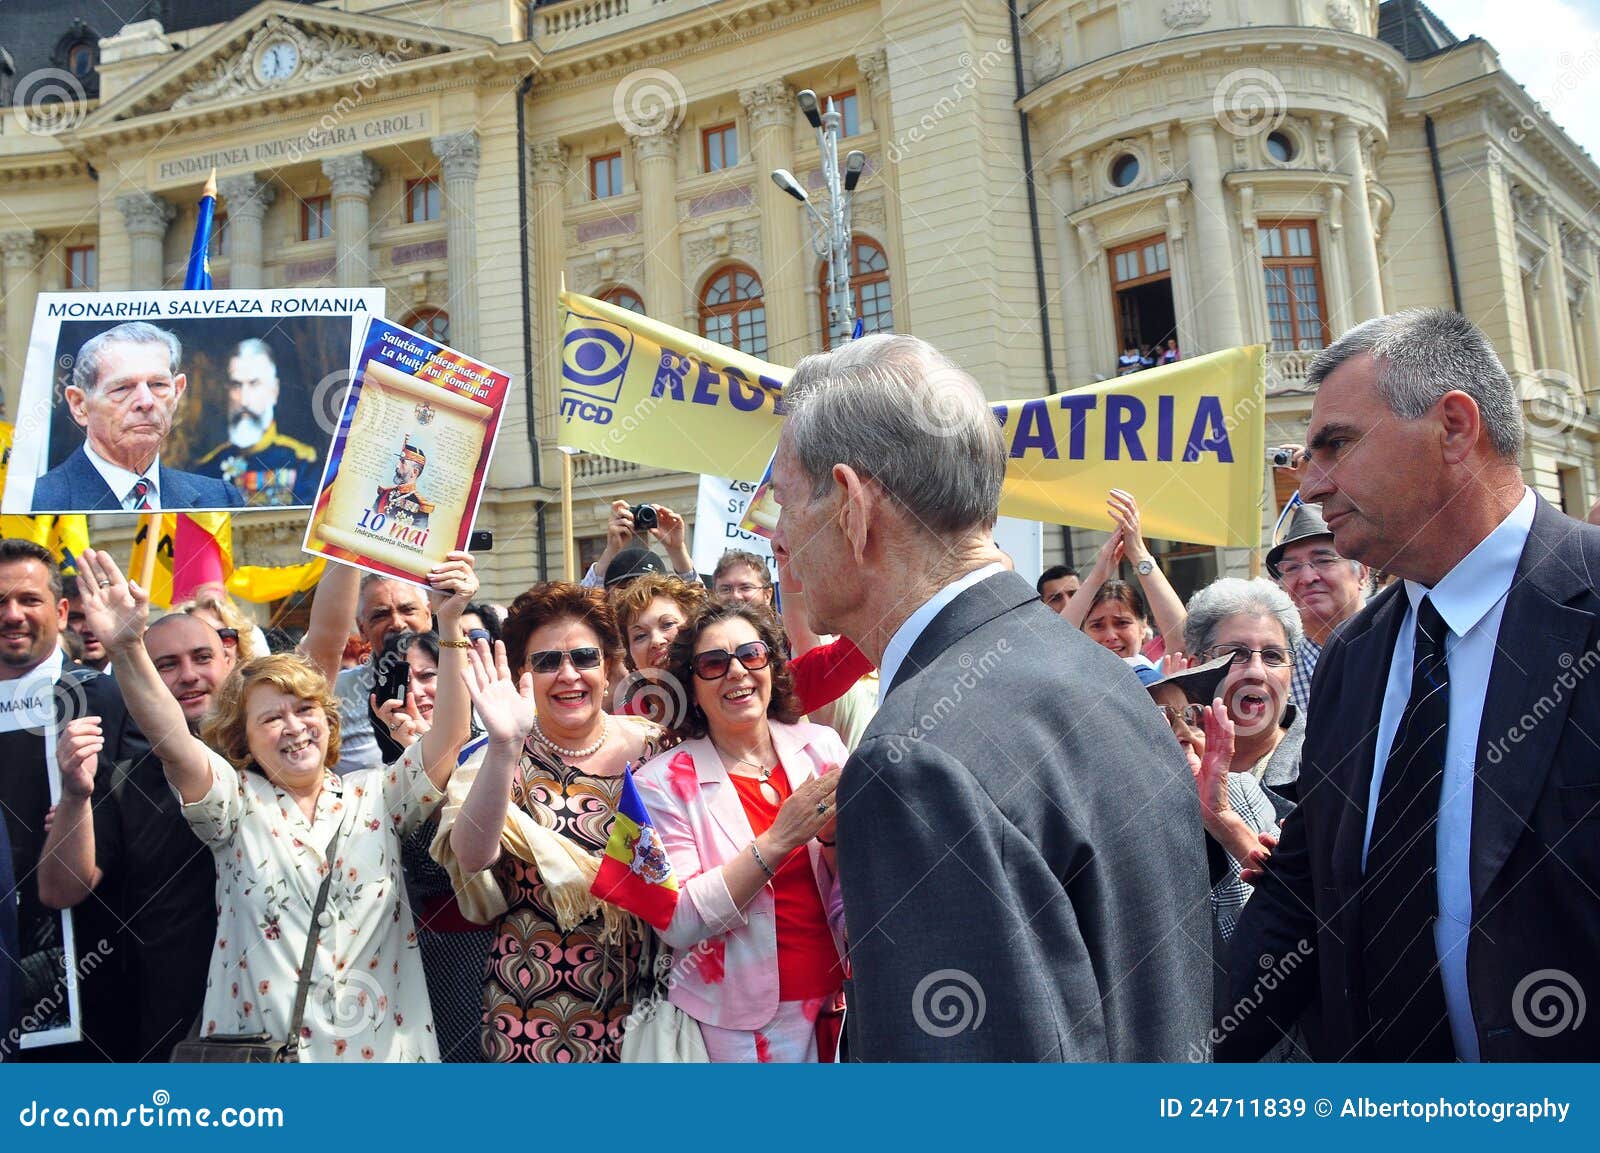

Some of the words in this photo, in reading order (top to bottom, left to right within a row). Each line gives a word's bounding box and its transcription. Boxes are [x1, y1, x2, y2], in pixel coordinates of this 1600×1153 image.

[363, 115, 413, 138] CAROL
[419, 112, 425, 129] I
[48, 301, 160, 317] MONARHIA
[168, 299, 263, 316] SALVEAZA
[271, 298, 367, 313] ROMANIA
[381, 331, 424, 357] Salutăm
[381, 345, 394, 359] La
[424, 365, 442, 379] Ani
[357, 508, 386, 532] 10
[389, 522, 429, 546] mai
